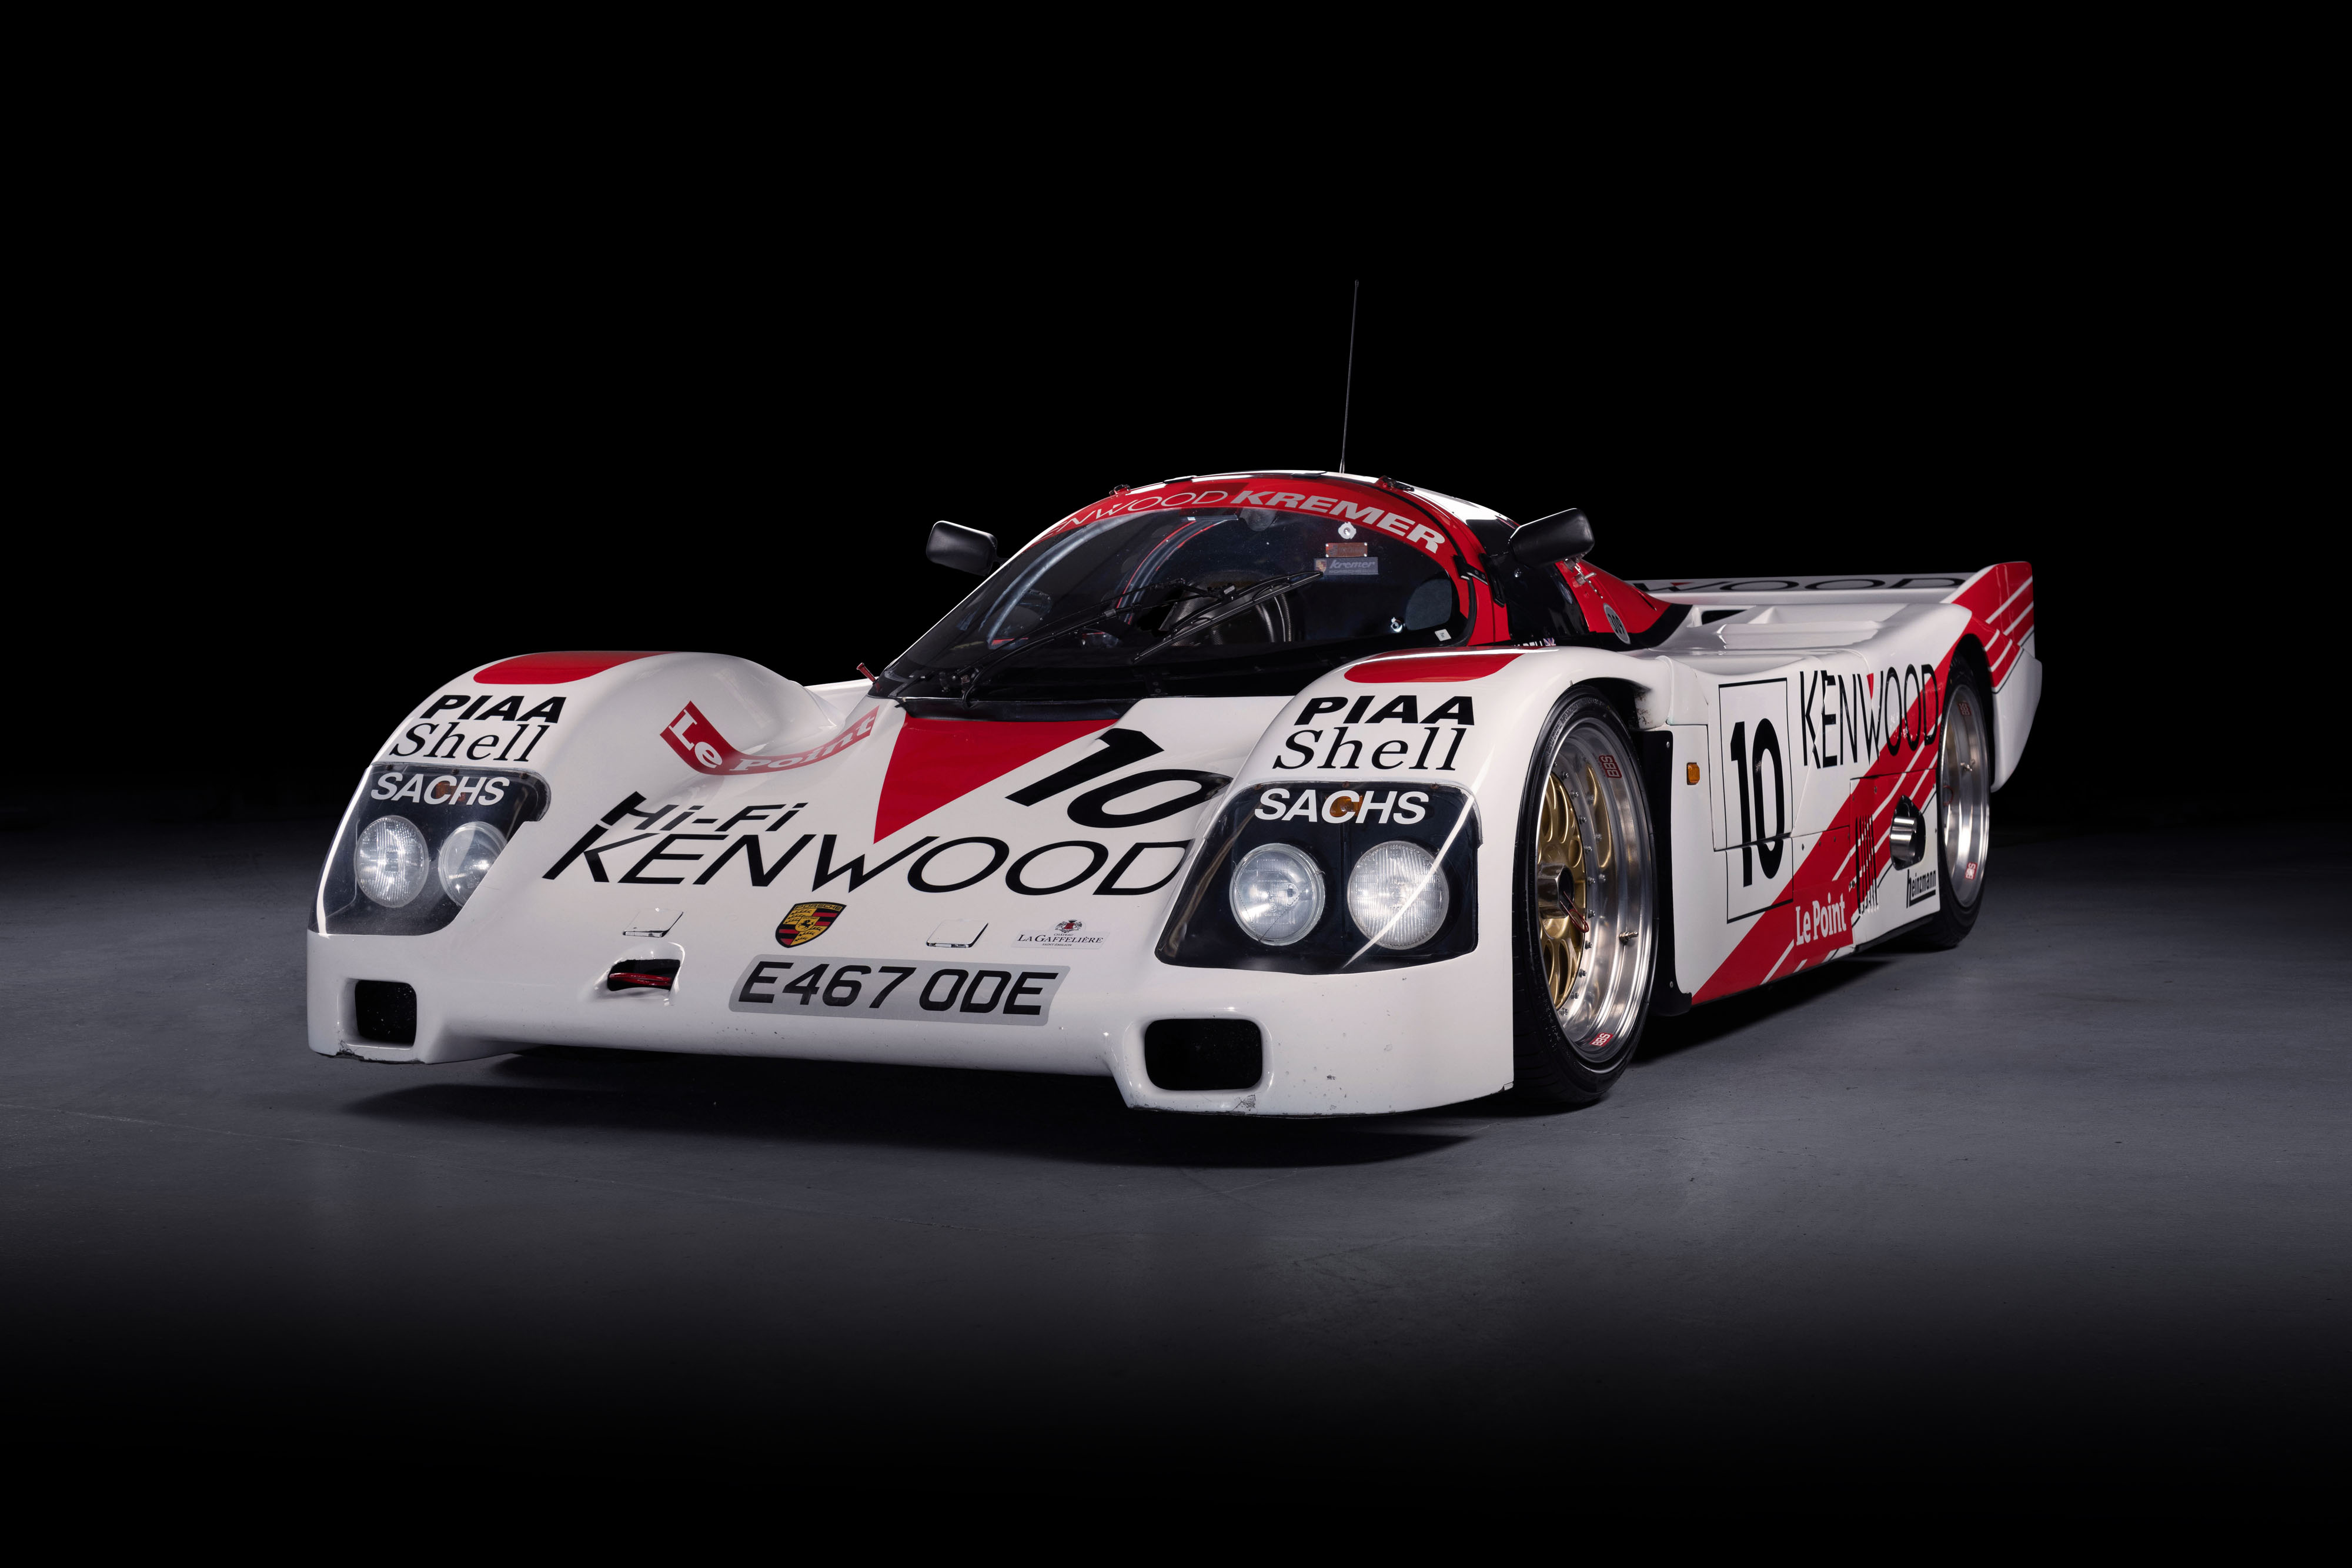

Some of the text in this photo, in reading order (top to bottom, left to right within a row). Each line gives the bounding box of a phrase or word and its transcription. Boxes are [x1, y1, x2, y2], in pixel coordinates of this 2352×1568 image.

[1230, 490, 1446, 554] KREMER
[1329, 559, 1375, 569] kremer
[419, 694, 567, 724] PIAA
[1294, 696, 1475, 726] PIAA
[1799, 664, 1940, 770] KENWOOD
[389, 722, 550, 762] Shell
[668, 709, 875, 772] Le Point
[1272, 727, 1466, 771] Shell
[1005, 728, 1234, 828] 10
[1601, 755, 1618, 777] BBS
[370, 772, 510, 805] SACHS
[1255, 789, 1428, 824] SACHS
[1730, 718, 1783, 888] 10
[600, 791, 808, 832] Hi-Fi
[542, 823, 1195, 896] KENWOOD
[1906, 869, 1936, 908] heinzmann
[1795, 892, 1847, 946] Le Point
[738, 961, 1059, 1015] E467 ODE
[1591, 1032, 1611, 1047] BBS
